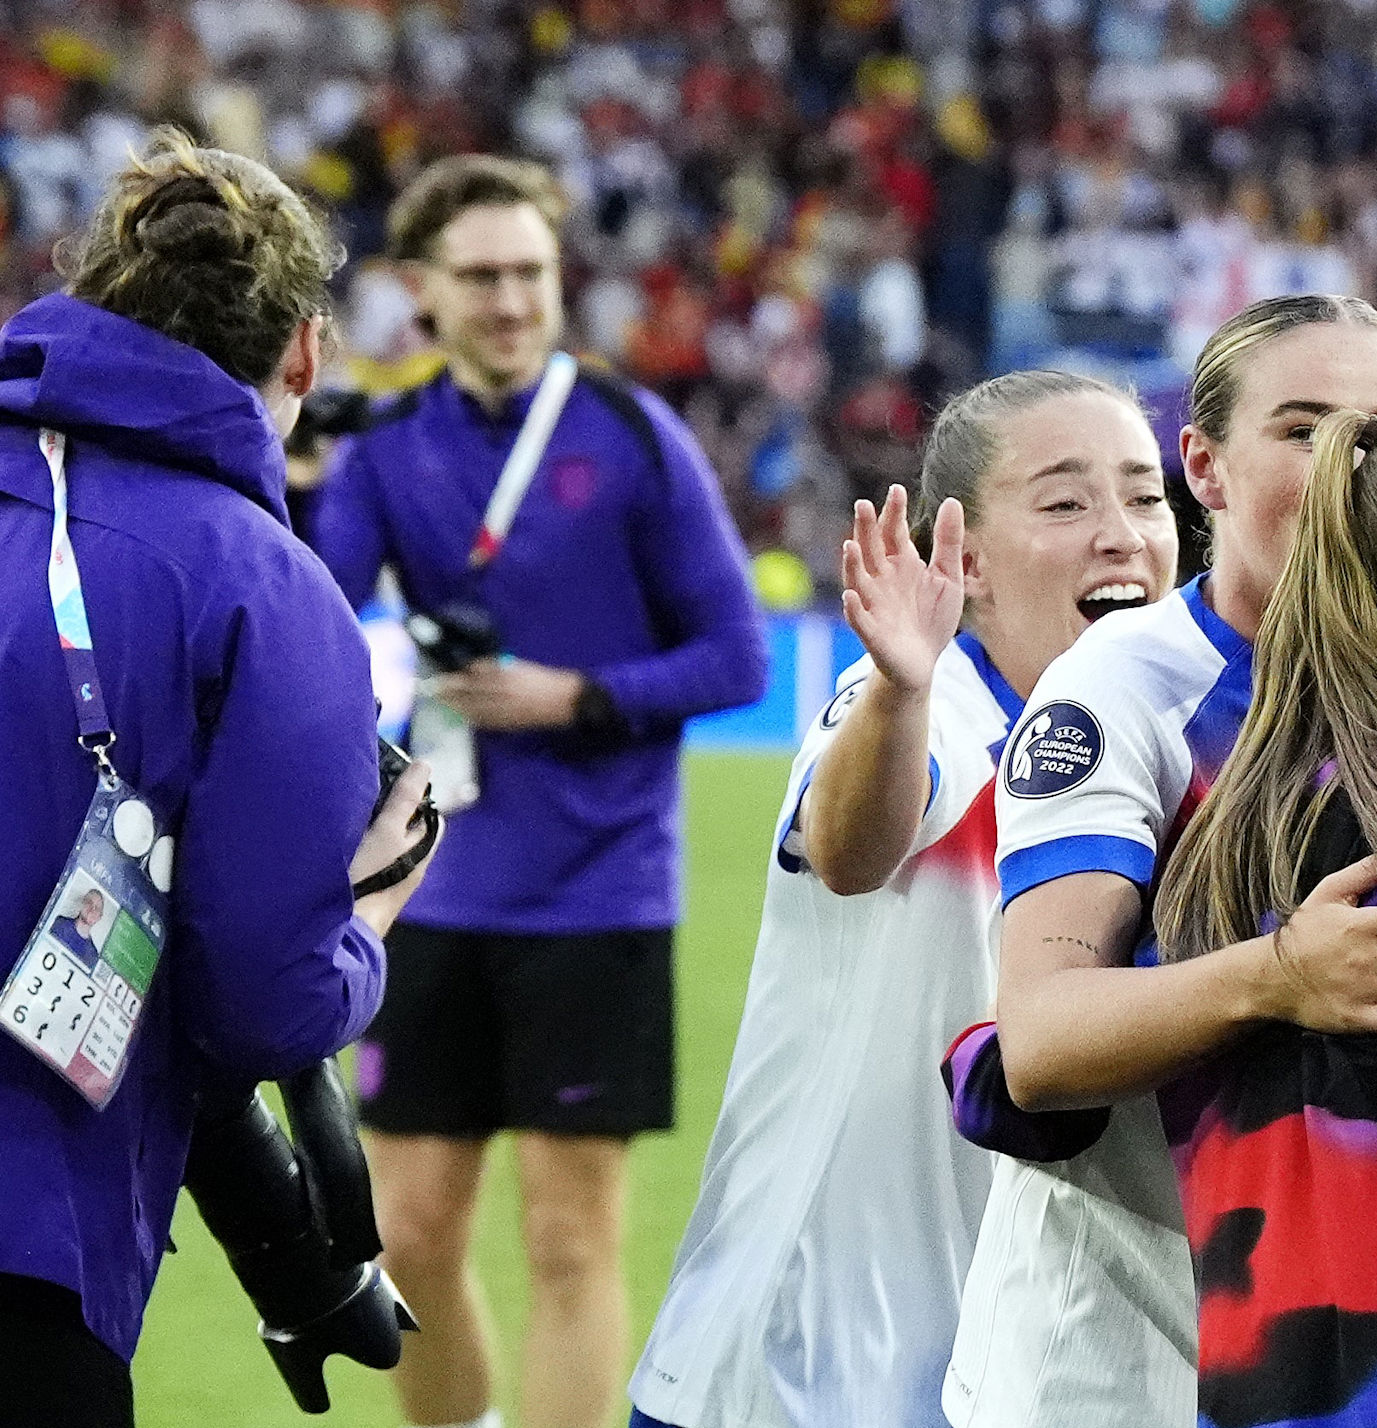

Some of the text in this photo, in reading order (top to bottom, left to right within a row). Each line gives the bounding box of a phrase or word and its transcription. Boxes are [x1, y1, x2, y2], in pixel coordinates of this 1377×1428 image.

[1055, 728, 1084, 742] UEFA
[1033, 748, 1092, 766] CHAMPIONS
[1039, 740, 1093, 757] EUROPEAN
[1039, 760, 1075, 775] 2022
[27, 976, 43, 996] 3
[42, 952, 96, 1008] 0 1 2
[13, 1004, 29, 1025] 6
